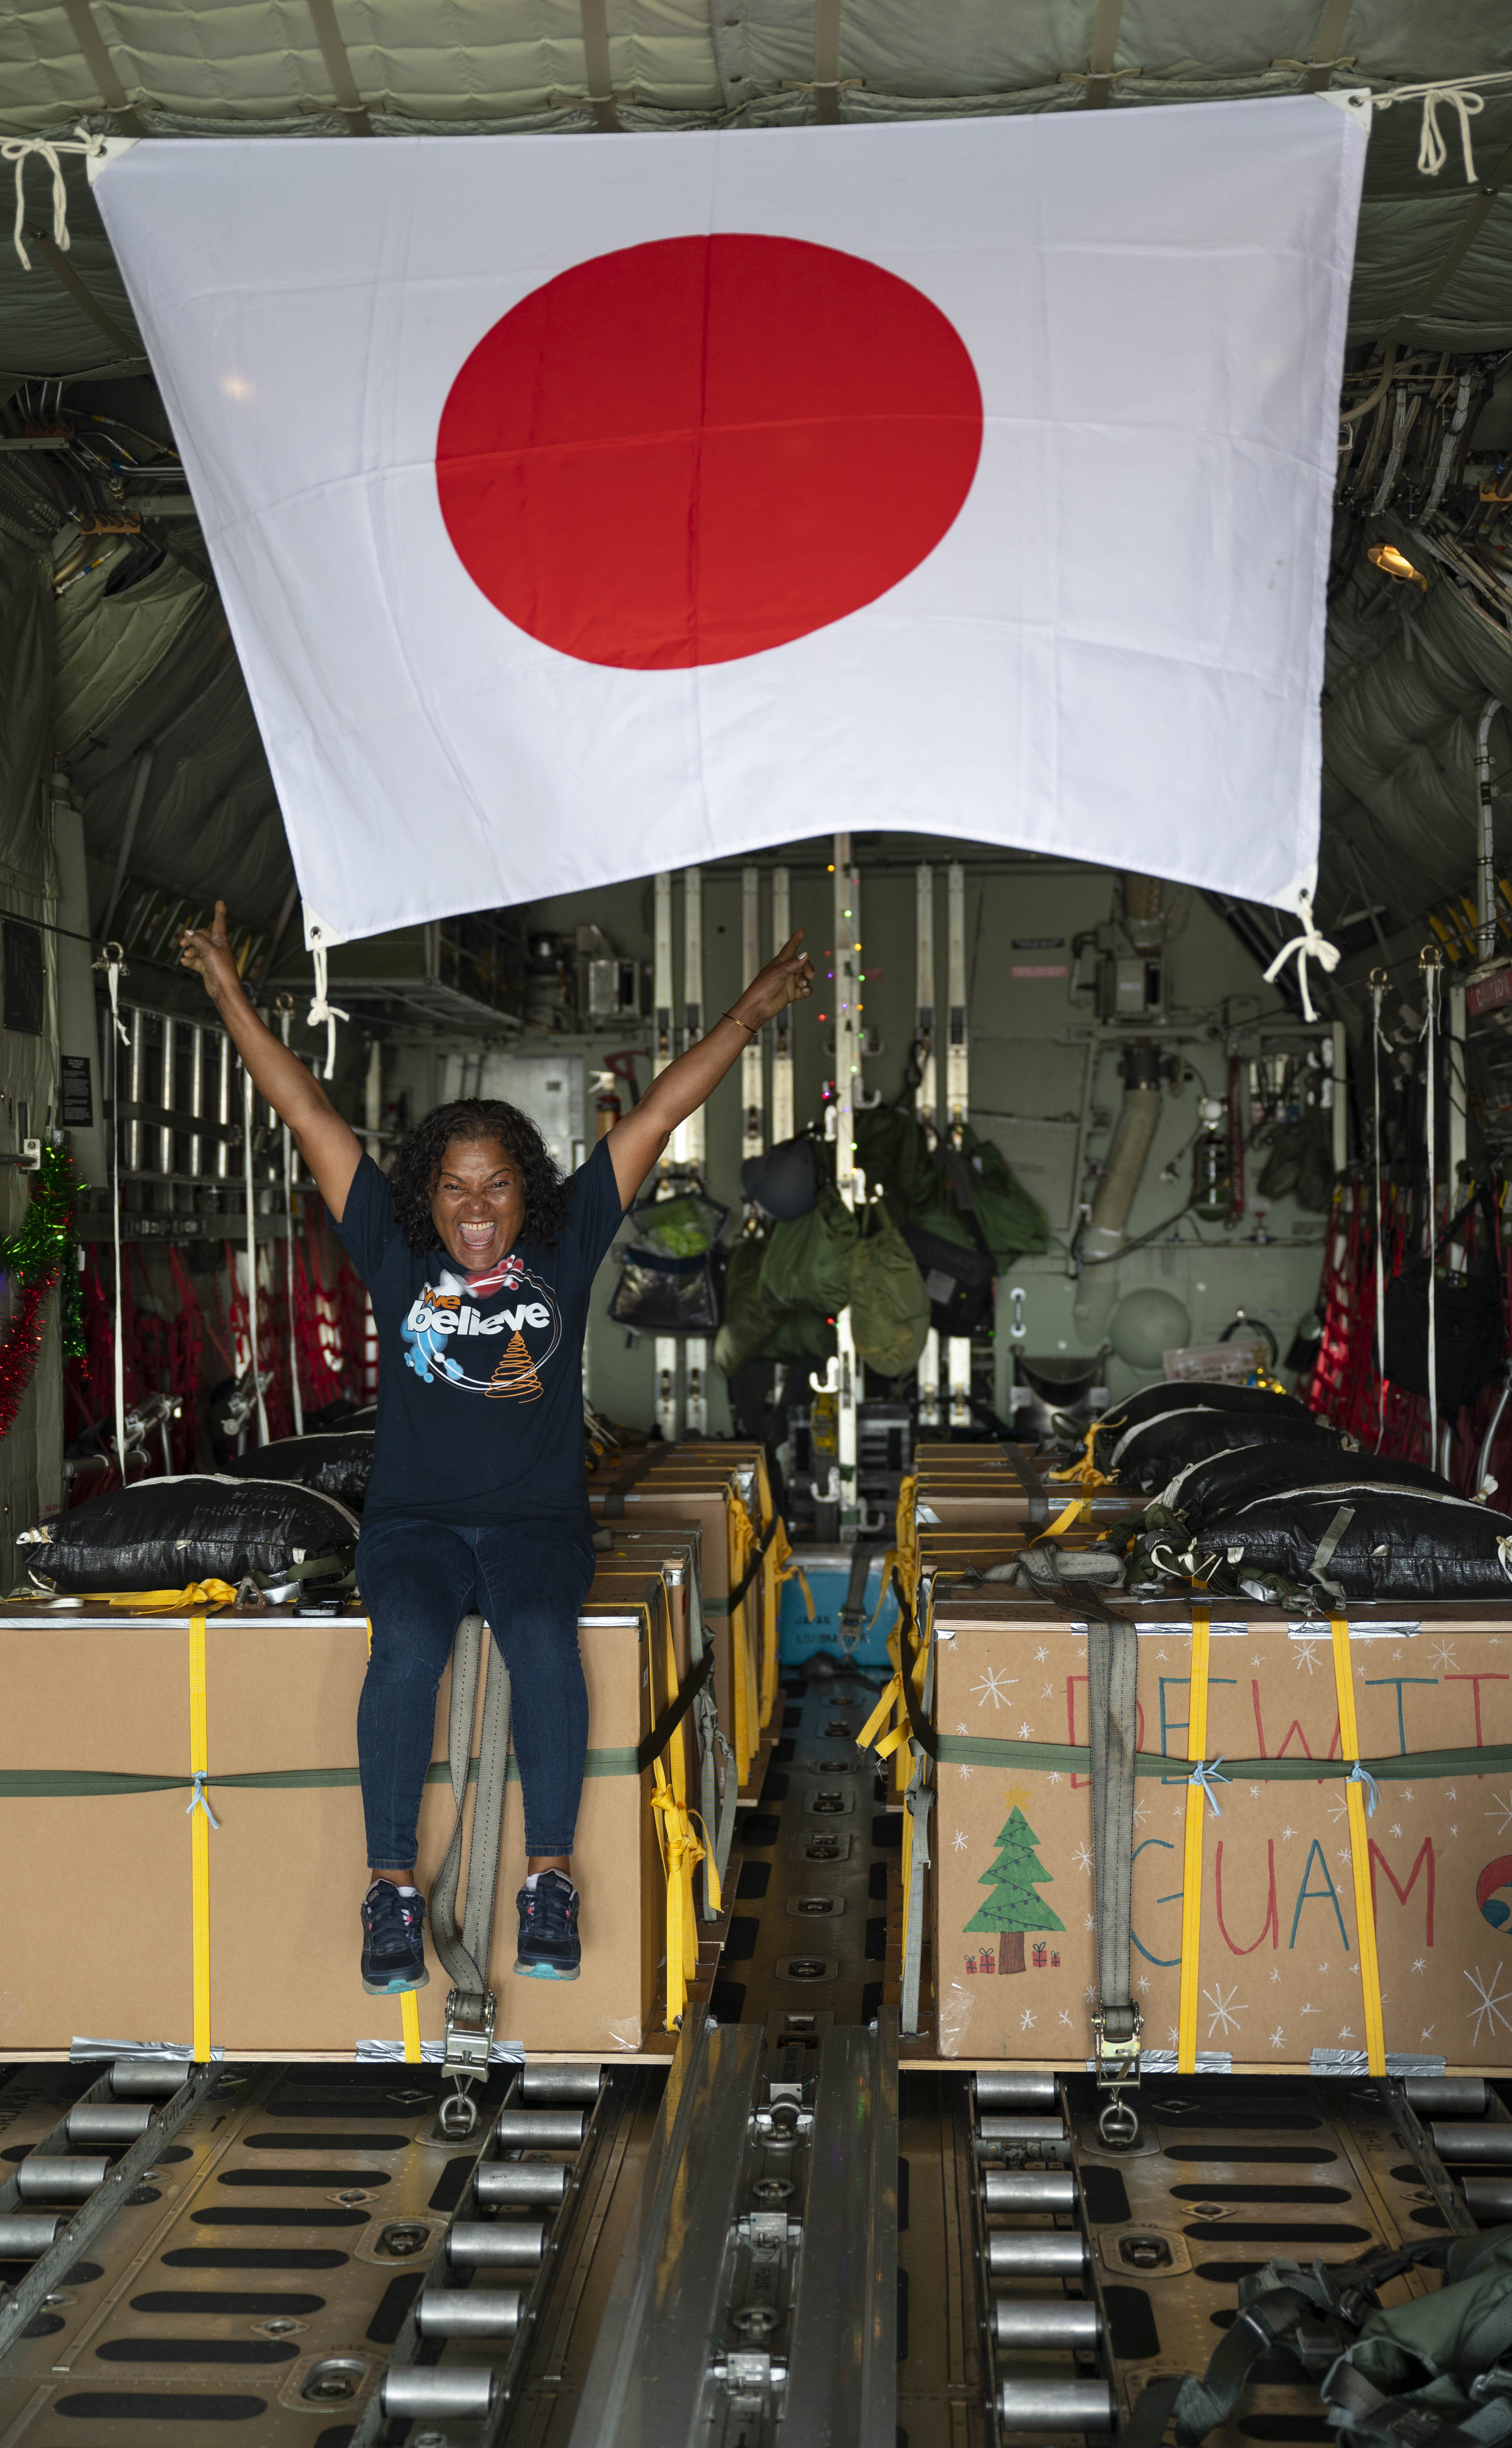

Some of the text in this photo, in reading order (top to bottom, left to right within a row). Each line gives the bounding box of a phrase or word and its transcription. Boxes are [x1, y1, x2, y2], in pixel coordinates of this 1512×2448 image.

[423, 1287, 461, 1310] we
[406, 1300, 550, 1336] believe
[793, 1615, 831, 1625] JAAN
[1130, 1837, 1436, 1967] GUAM
